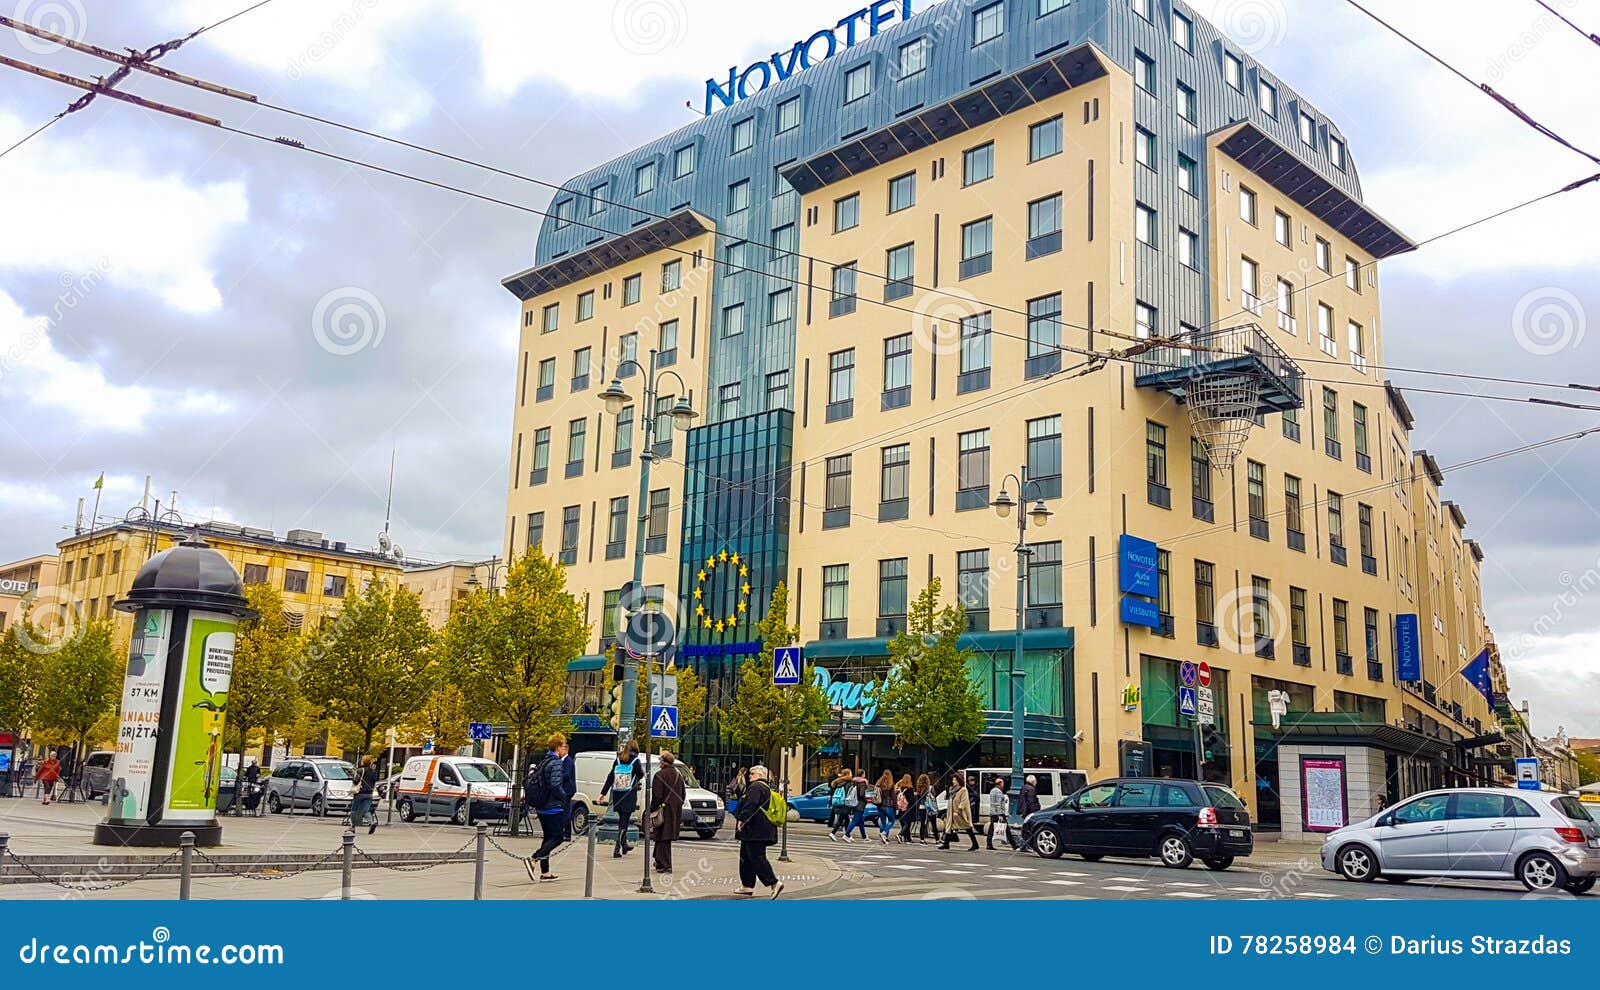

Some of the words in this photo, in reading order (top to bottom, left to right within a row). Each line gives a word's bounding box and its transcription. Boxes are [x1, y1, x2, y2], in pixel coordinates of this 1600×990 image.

[1127, 551, 1155, 567] NOVOTEL
[1401, 616, 1412, 667] NOVOTEL
[131, 688, 141, 697] 37
[143, 688, 159, 698] KM
[121, 711, 160, 722] ILNIAUS
